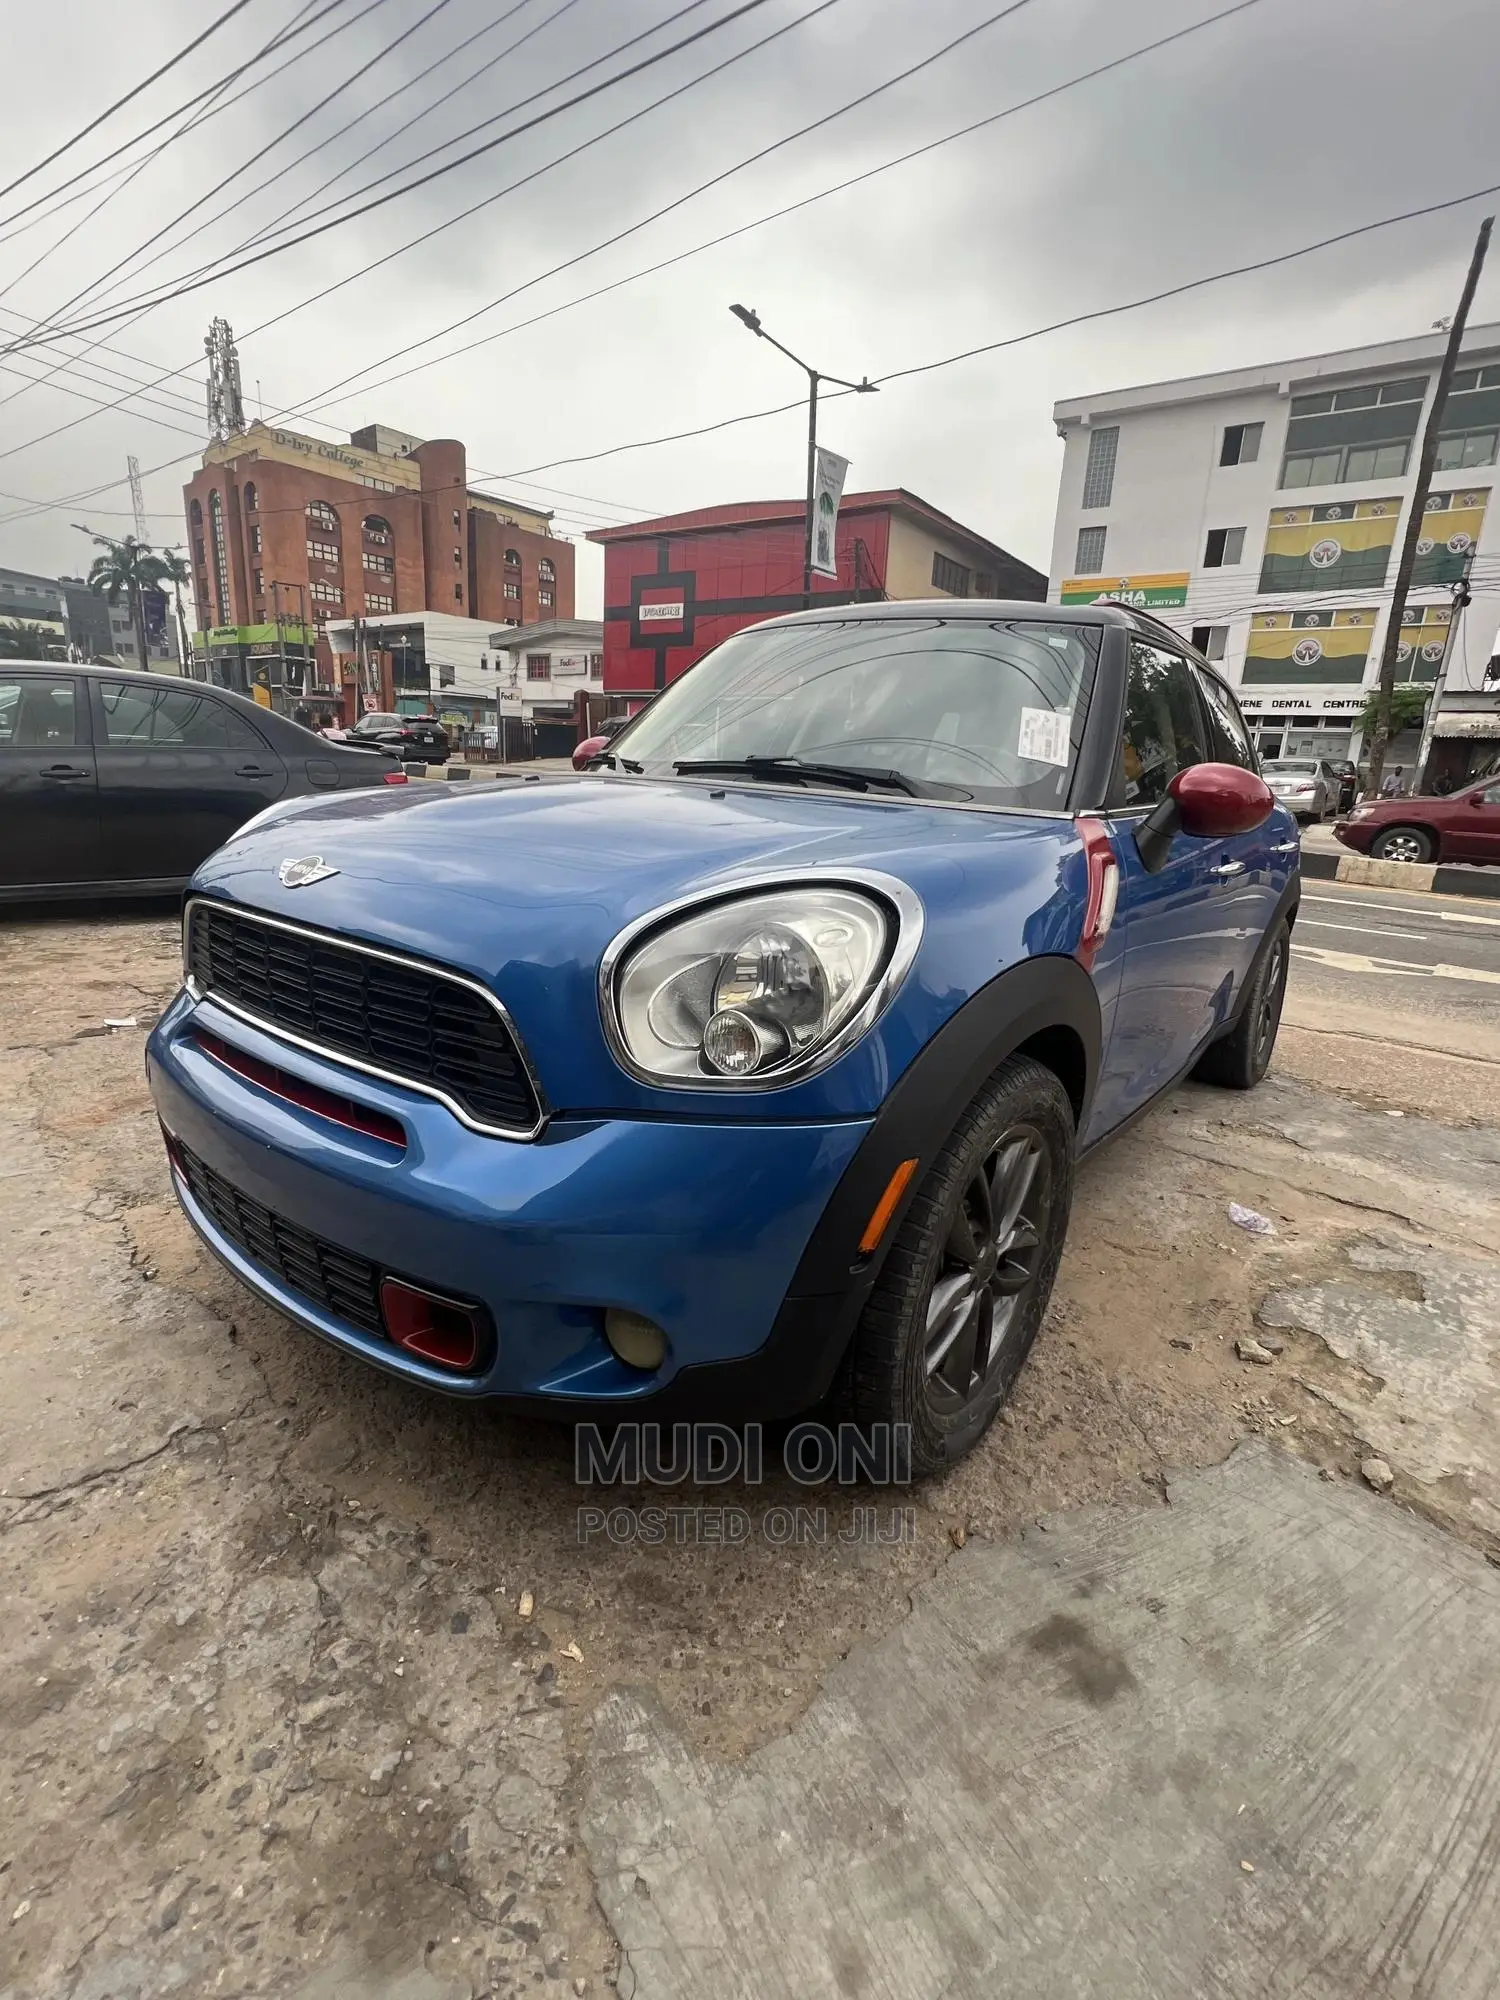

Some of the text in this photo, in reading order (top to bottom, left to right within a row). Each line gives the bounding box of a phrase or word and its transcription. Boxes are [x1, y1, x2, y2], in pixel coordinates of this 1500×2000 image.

[275, 432, 363, 470] D-Ivy College
[1097, 590, 1147, 602] ASHA
[1271, 699, 1312, 708] DENTAL
[1323, 699, 1367, 708] CENTRE
